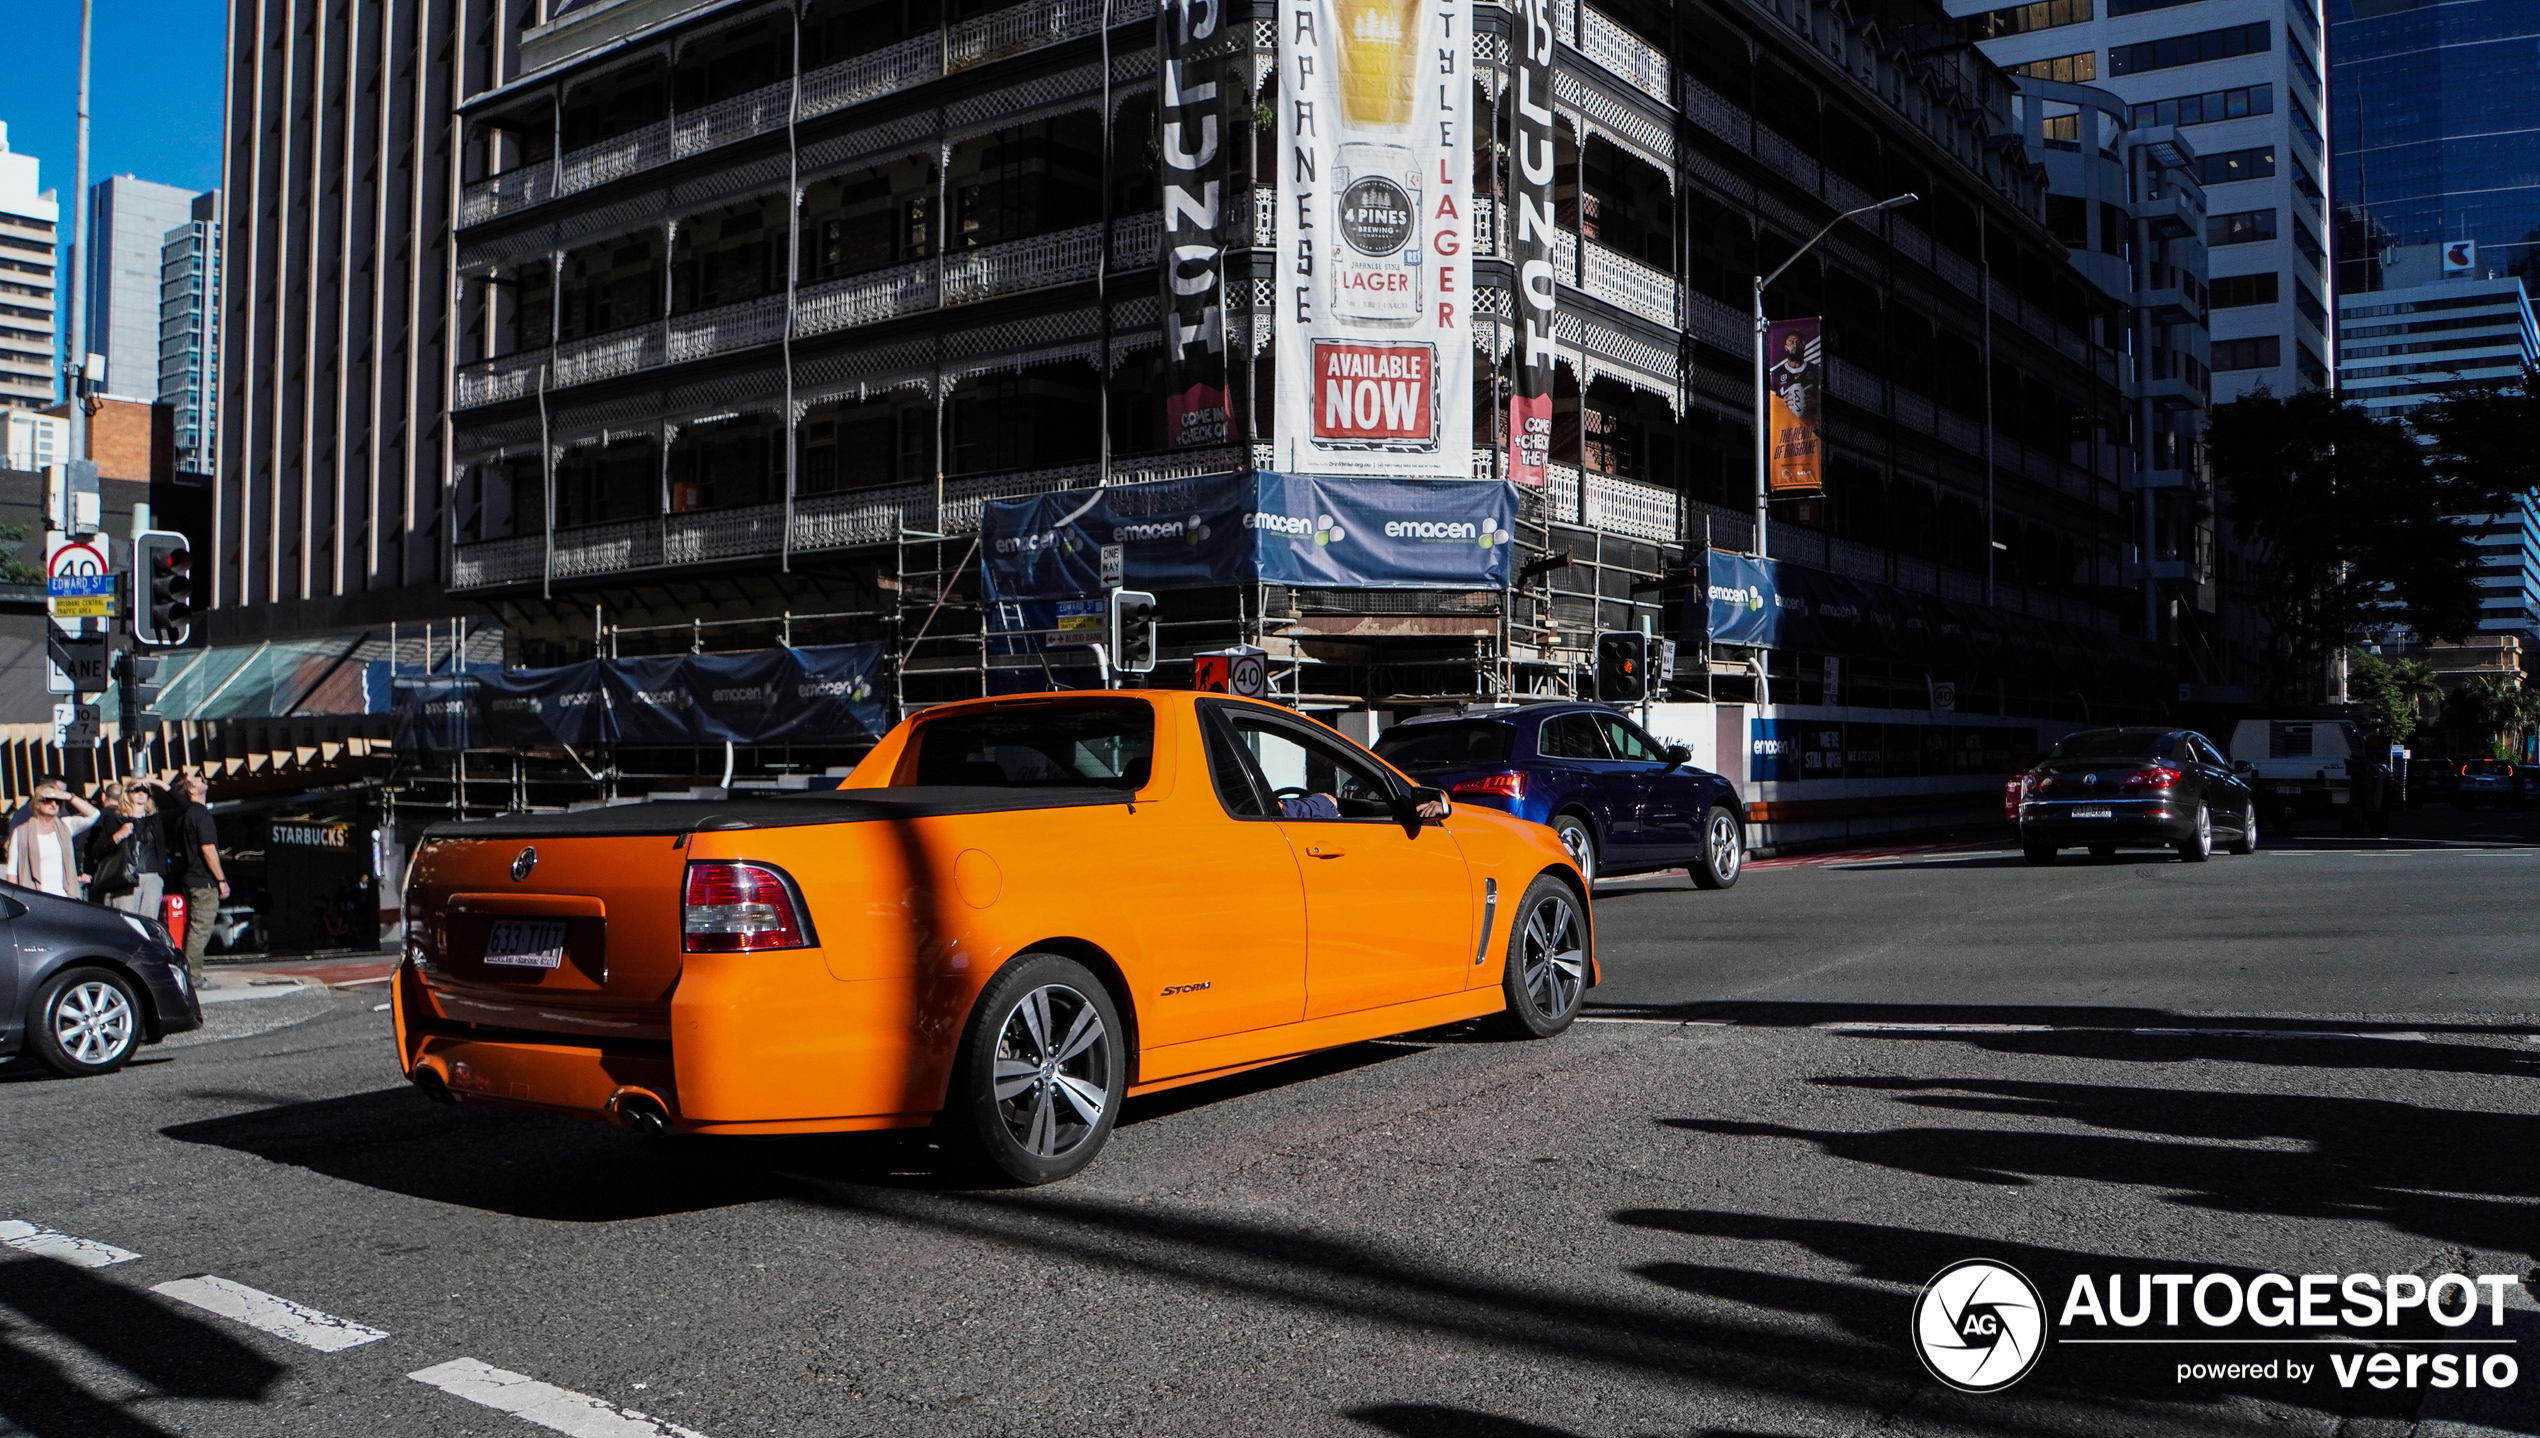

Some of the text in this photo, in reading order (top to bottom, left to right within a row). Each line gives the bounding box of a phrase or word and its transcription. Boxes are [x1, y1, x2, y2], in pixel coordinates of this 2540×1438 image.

[1295, 0, 1317, 324] APANESE
[1434, 0, 1461, 329] TYLE LAGER
[1345, 208, 1407, 225] 4 PINES
[1518, 65, 1556, 371] LUNCH
[1358, 226, 1394, 234] BREWING
[1351, 261, 1382, 270] JAPANESE
[1343, 271, 1408, 291] LAGER
[1327, 353, 1422, 380] AVAILABLE
[1326, 379, 1423, 431] NOW
[1181, 408, 1211, 428] COME
[1521, 450, 1541, 467] THE
[1242, 512, 1312, 534] emacen
[1384, 521, 1476, 539] emacen
[1113, 521, 1184, 543] emacen
[1103, 548, 1119, 560] ONE
[59, 560, 97, 576] 40
[1103, 562, 1120, 573] WAY
[52, 576, 88, 591] EDWARD
[1708, 585, 1749, 603] emacen
[1060, 601, 1084, 612] EDWARD
[54, 660, 102, 677] LANE
[1236, 667, 1263, 687] 40
[712, 687, 762, 702] emacen
[1935, 690, 1952, 702] 40
[1754, 739, 1789, 755] emacen
[272, 824, 346, 848] STARBUCKS
